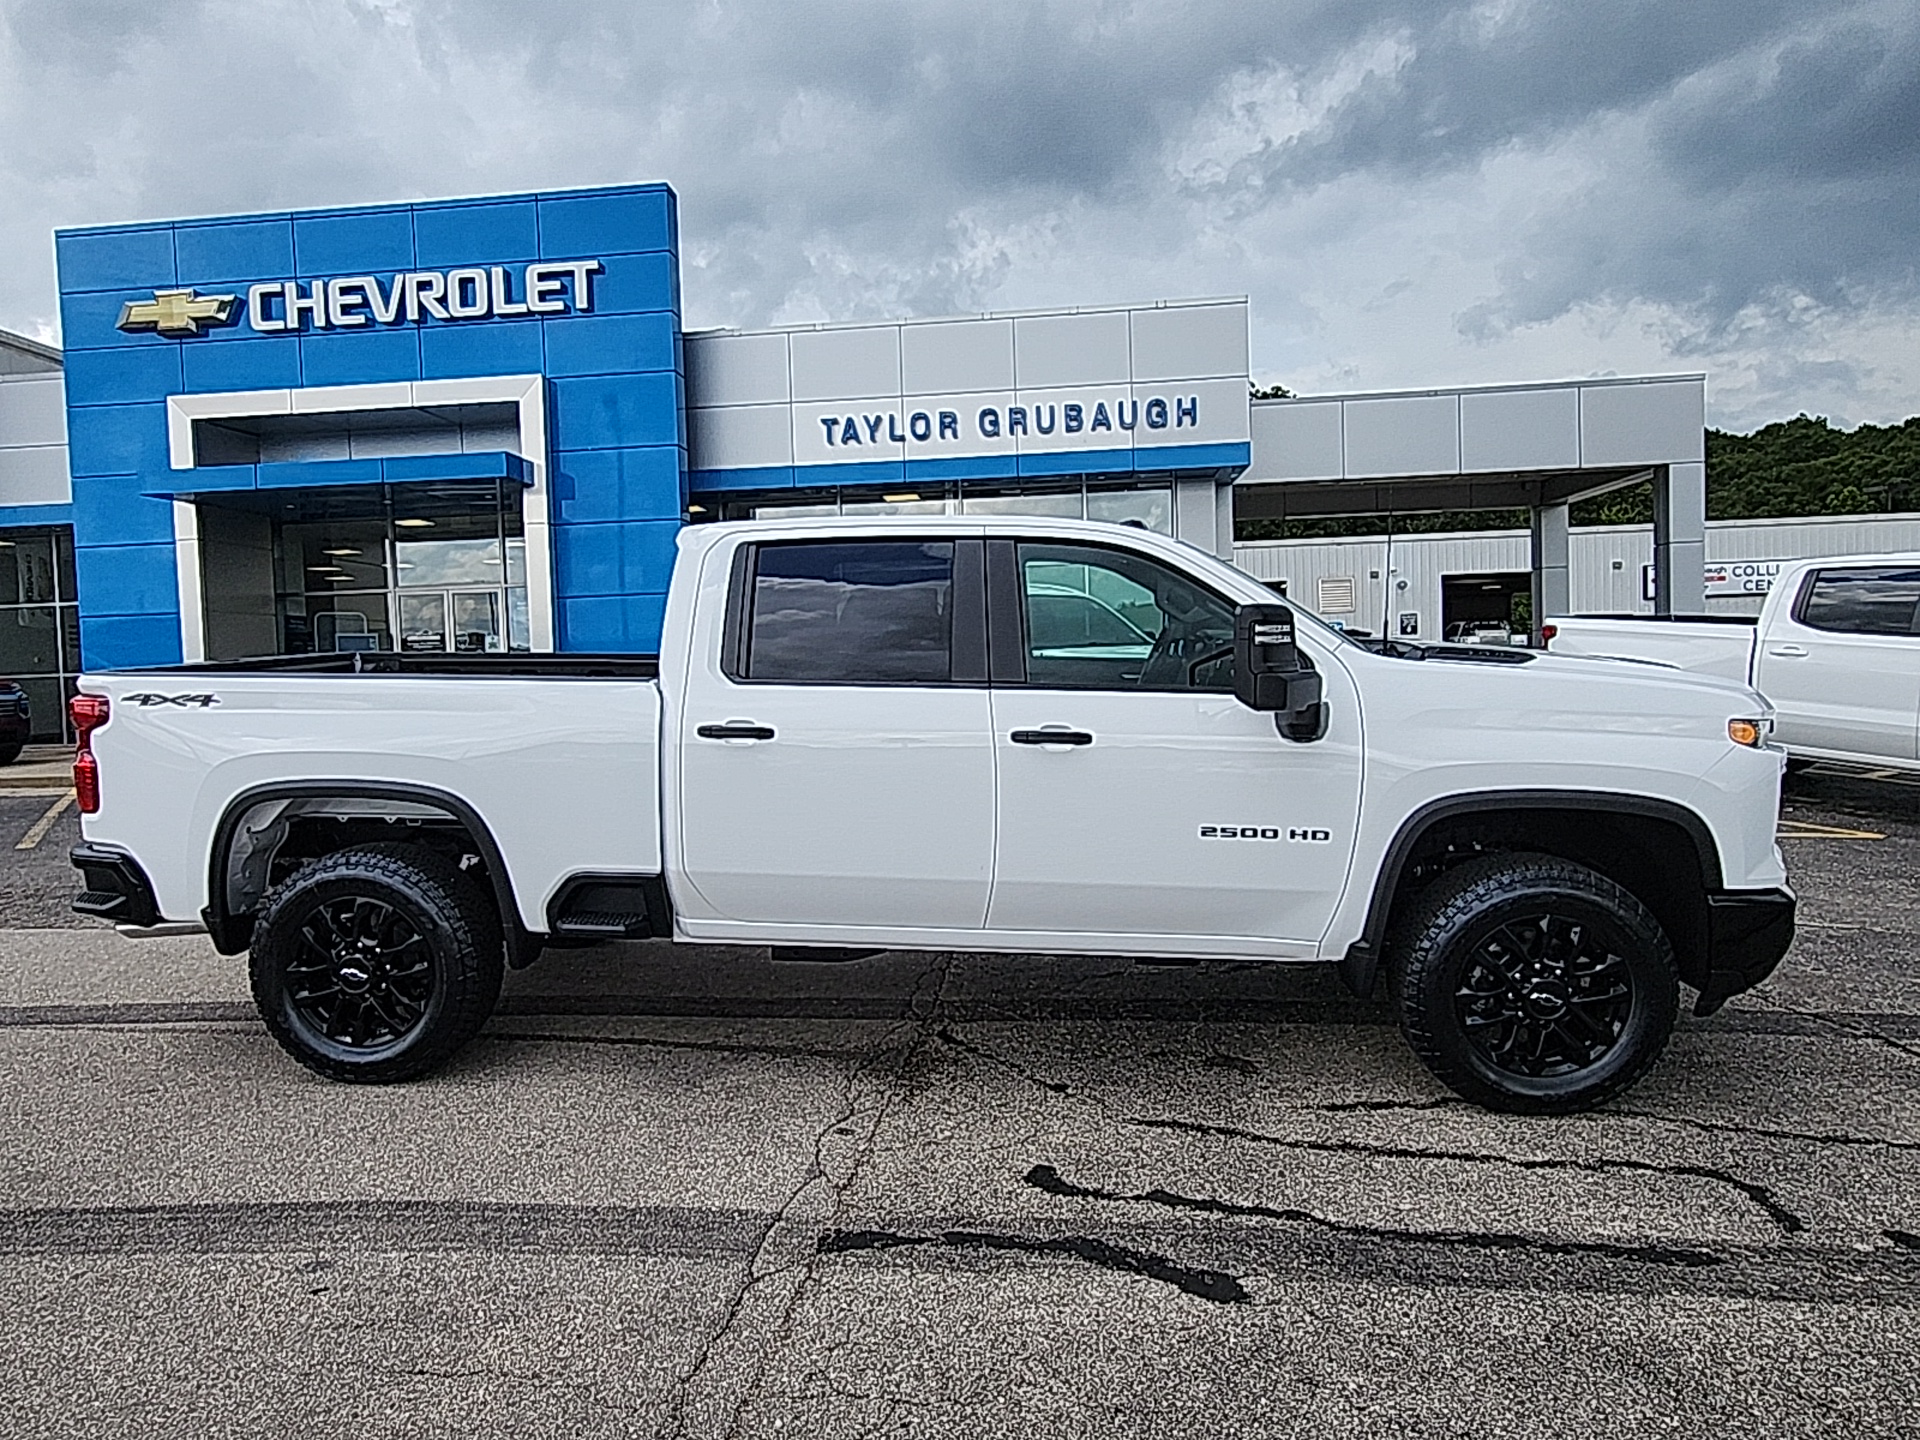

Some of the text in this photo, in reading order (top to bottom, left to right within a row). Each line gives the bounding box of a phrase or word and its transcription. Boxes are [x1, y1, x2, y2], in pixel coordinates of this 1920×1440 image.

[247, 259, 601, 332] CHEVROLET
[820, 396, 1199, 447] TAYLOR GRUBAUGH
[1200, 826, 1330, 841] 2500 HD
